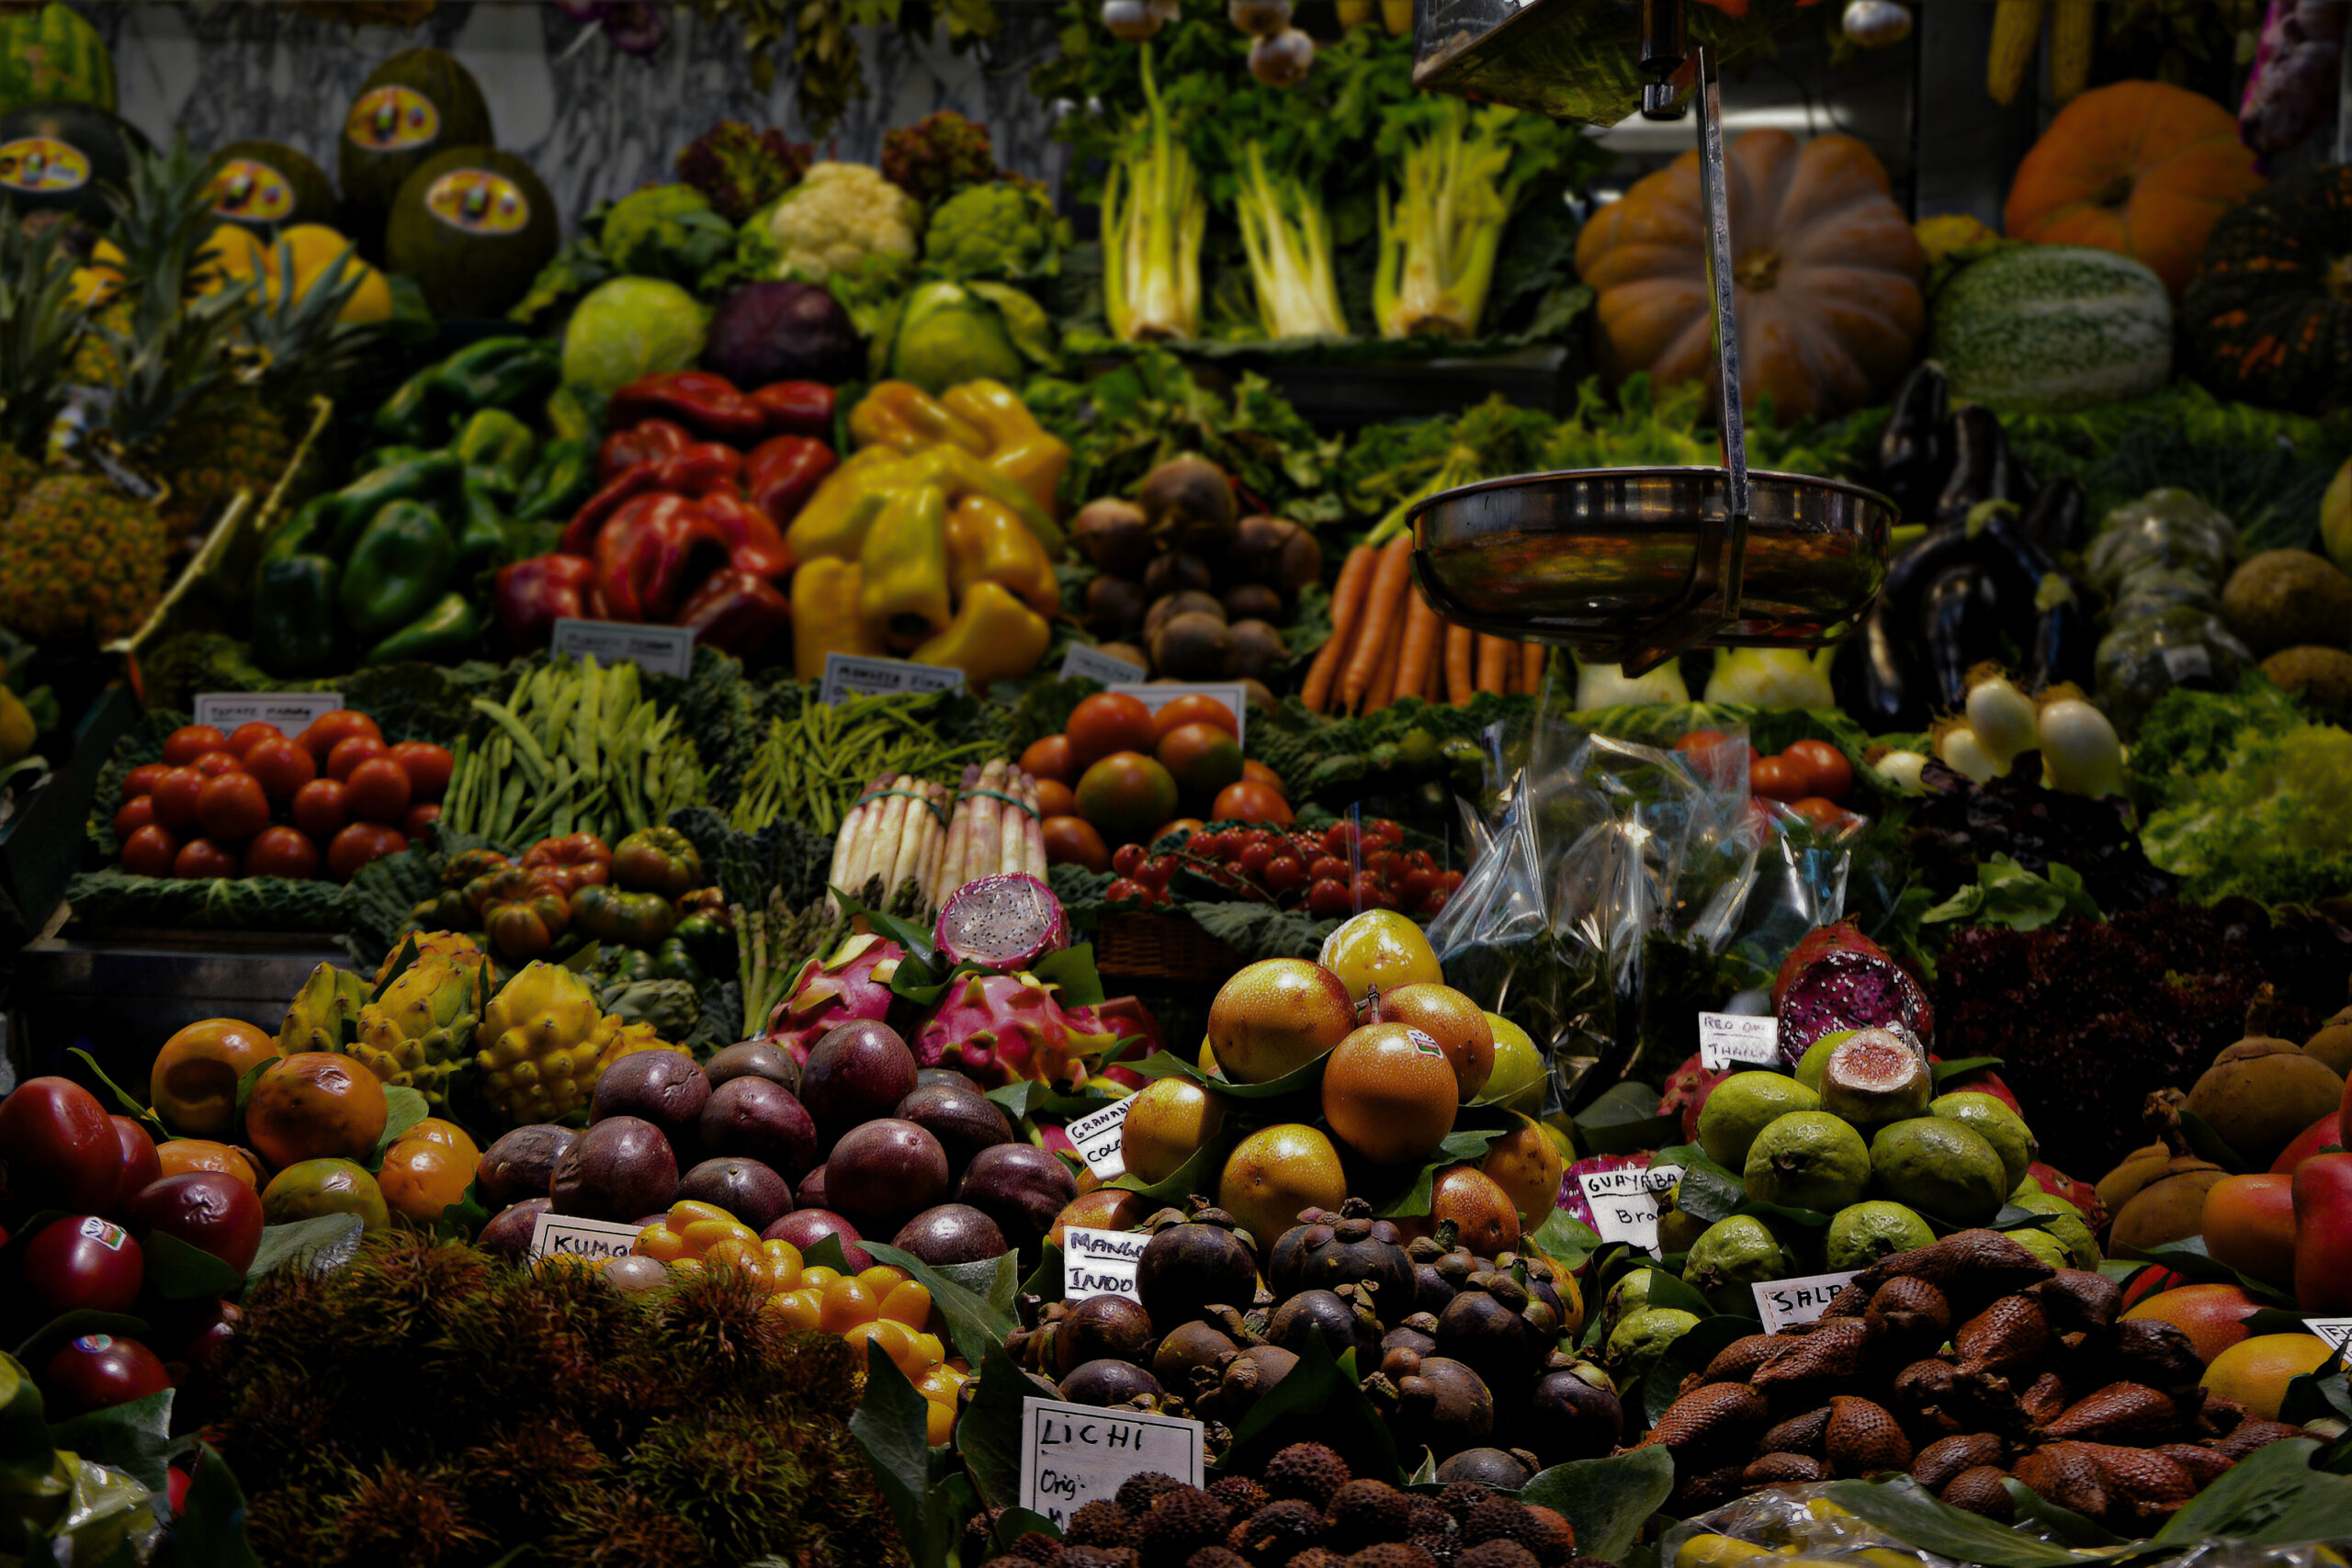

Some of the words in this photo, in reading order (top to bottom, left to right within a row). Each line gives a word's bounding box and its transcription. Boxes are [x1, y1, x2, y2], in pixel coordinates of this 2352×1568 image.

[1589, 1173, 1679, 1191] GUAYABA
[554, 1235, 633, 1258] KUMQ
[1040, 1416, 1143, 1450] LICHI
